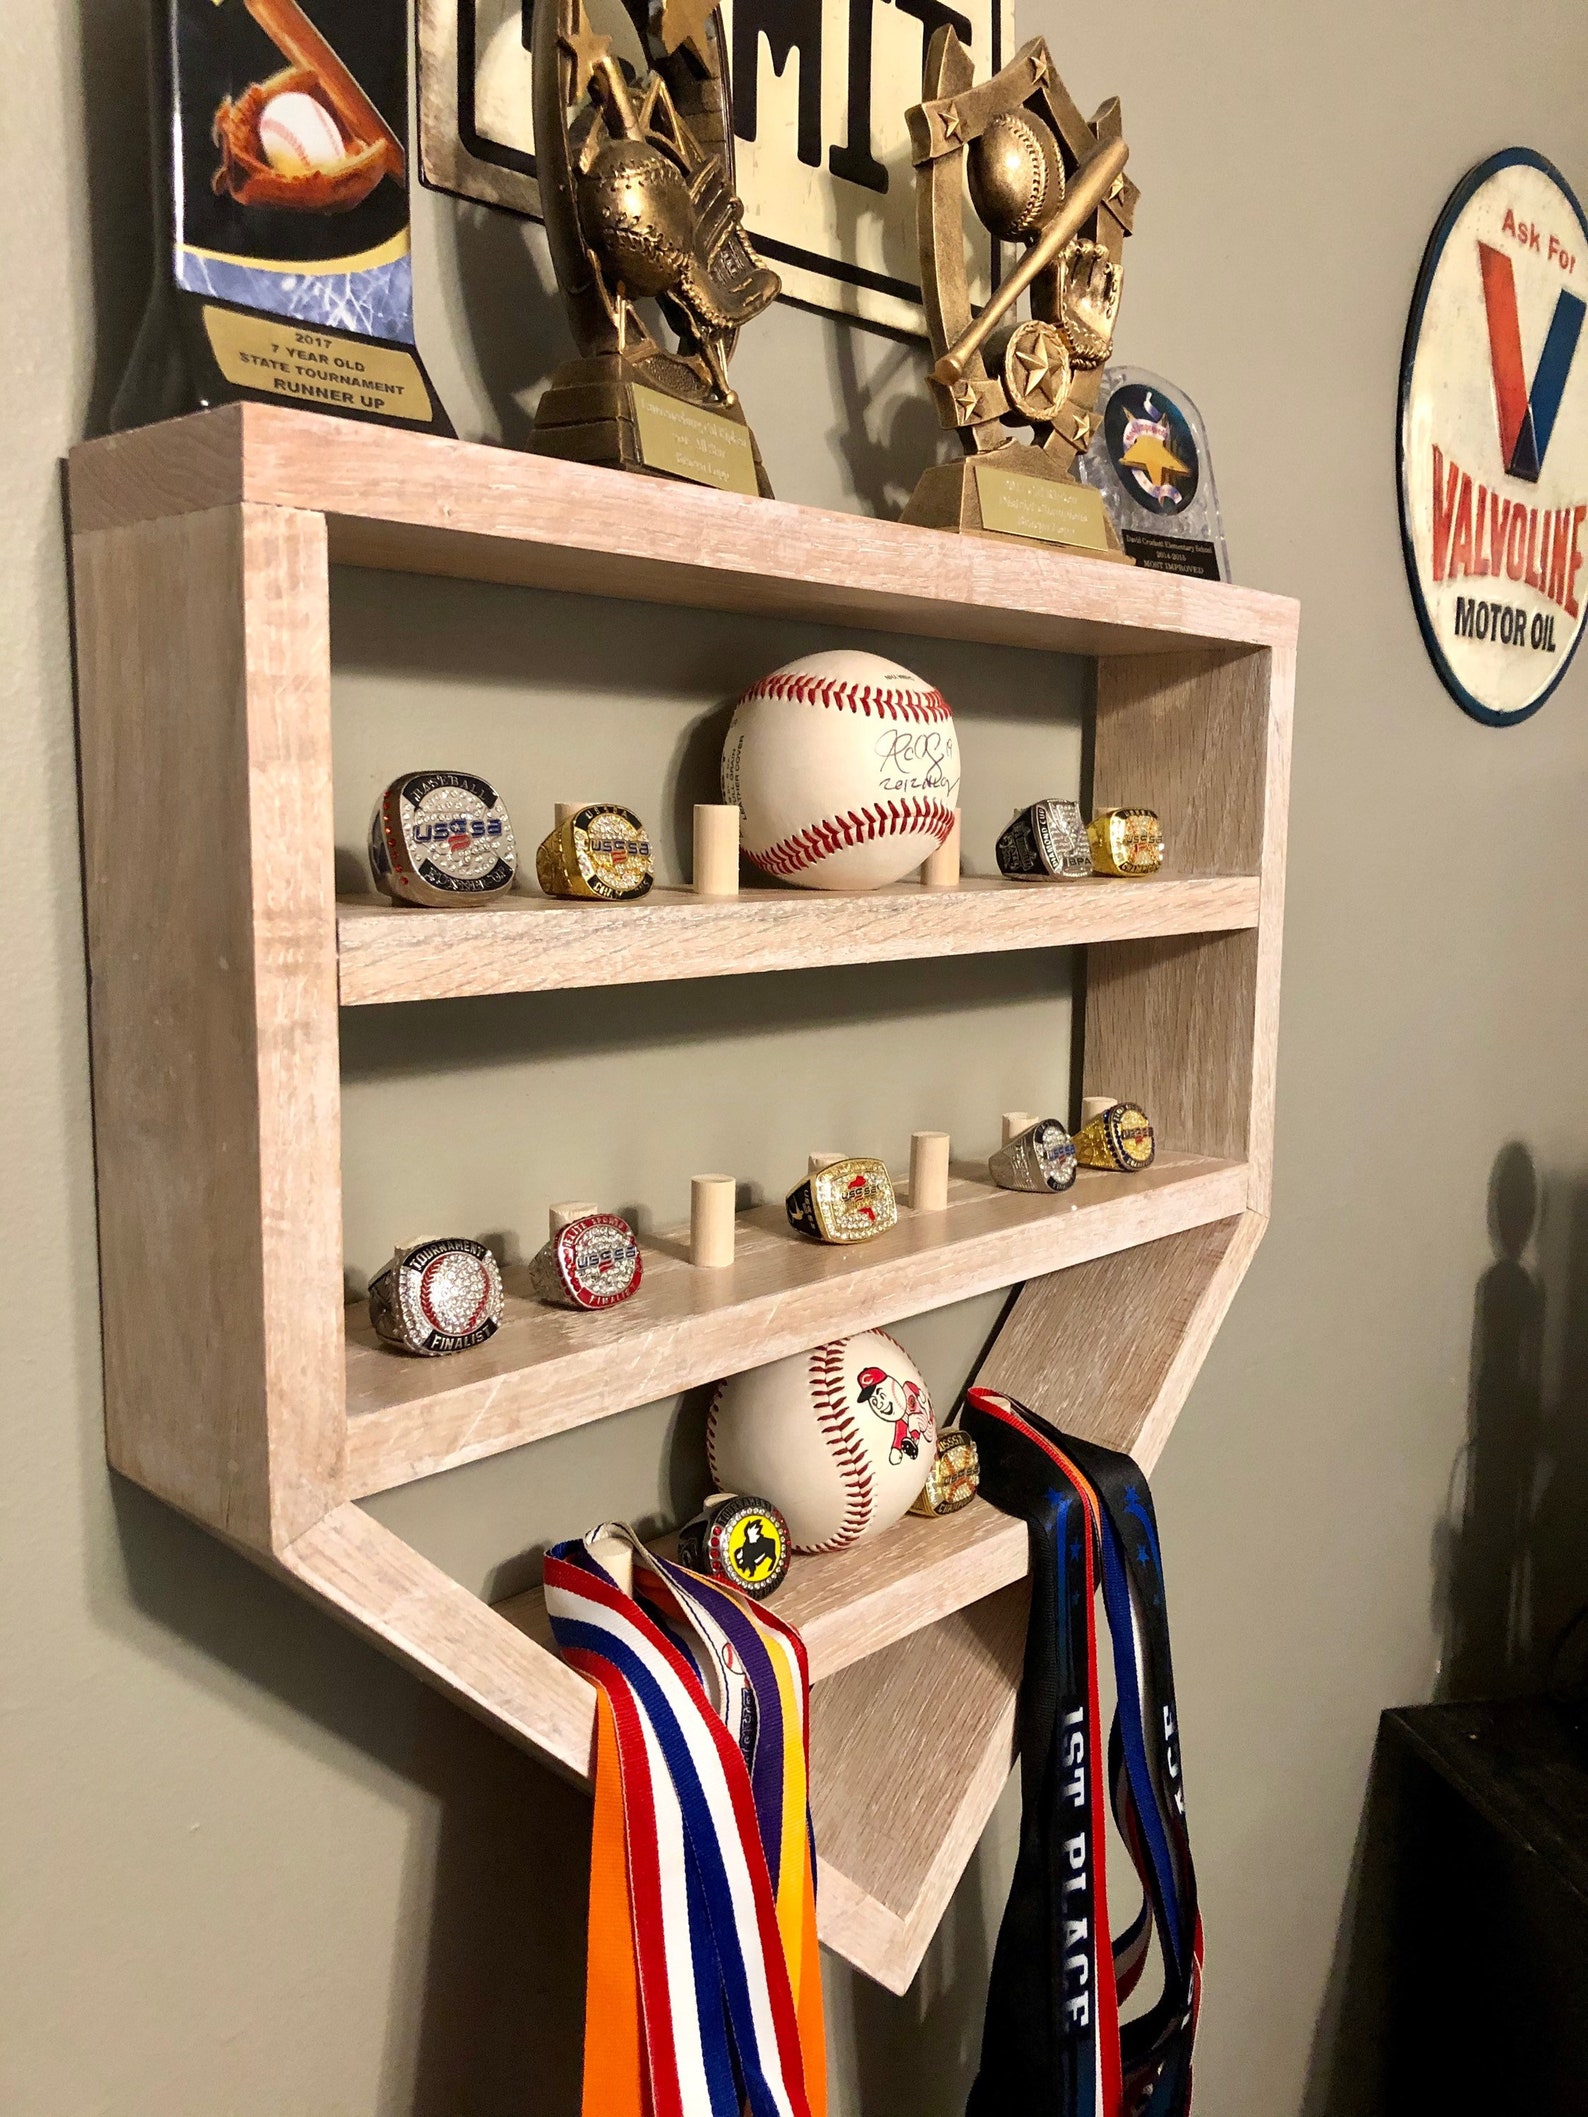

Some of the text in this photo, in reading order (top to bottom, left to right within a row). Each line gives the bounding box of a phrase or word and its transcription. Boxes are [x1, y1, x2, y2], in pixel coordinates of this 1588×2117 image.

[1502, 208, 1576, 274] Ask For
[295, 333, 332, 349] 2017
[239, 352, 405, 396] STATE TOURNAMENT
[270, 344, 365, 372] 7 YEAR OLD
[273, 377, 385, 409] RUNNER UP
[1432, 443, 1587, 620] VALVOLINE
[1143, 560, 1204, 574] MOST IMPROVED
[1454, 596, 1556, 653] MOTOR OIL
[410, 775, 486, 803] BASEBALL
[1038, 808, 1060, 869] DIAMOND CUP
[409, 1241, 485, 1271] TOURNAMENT
[430, 1325, 491, 1350] FINALIST
[1061, 1832, 1091, 2029] PLACE
